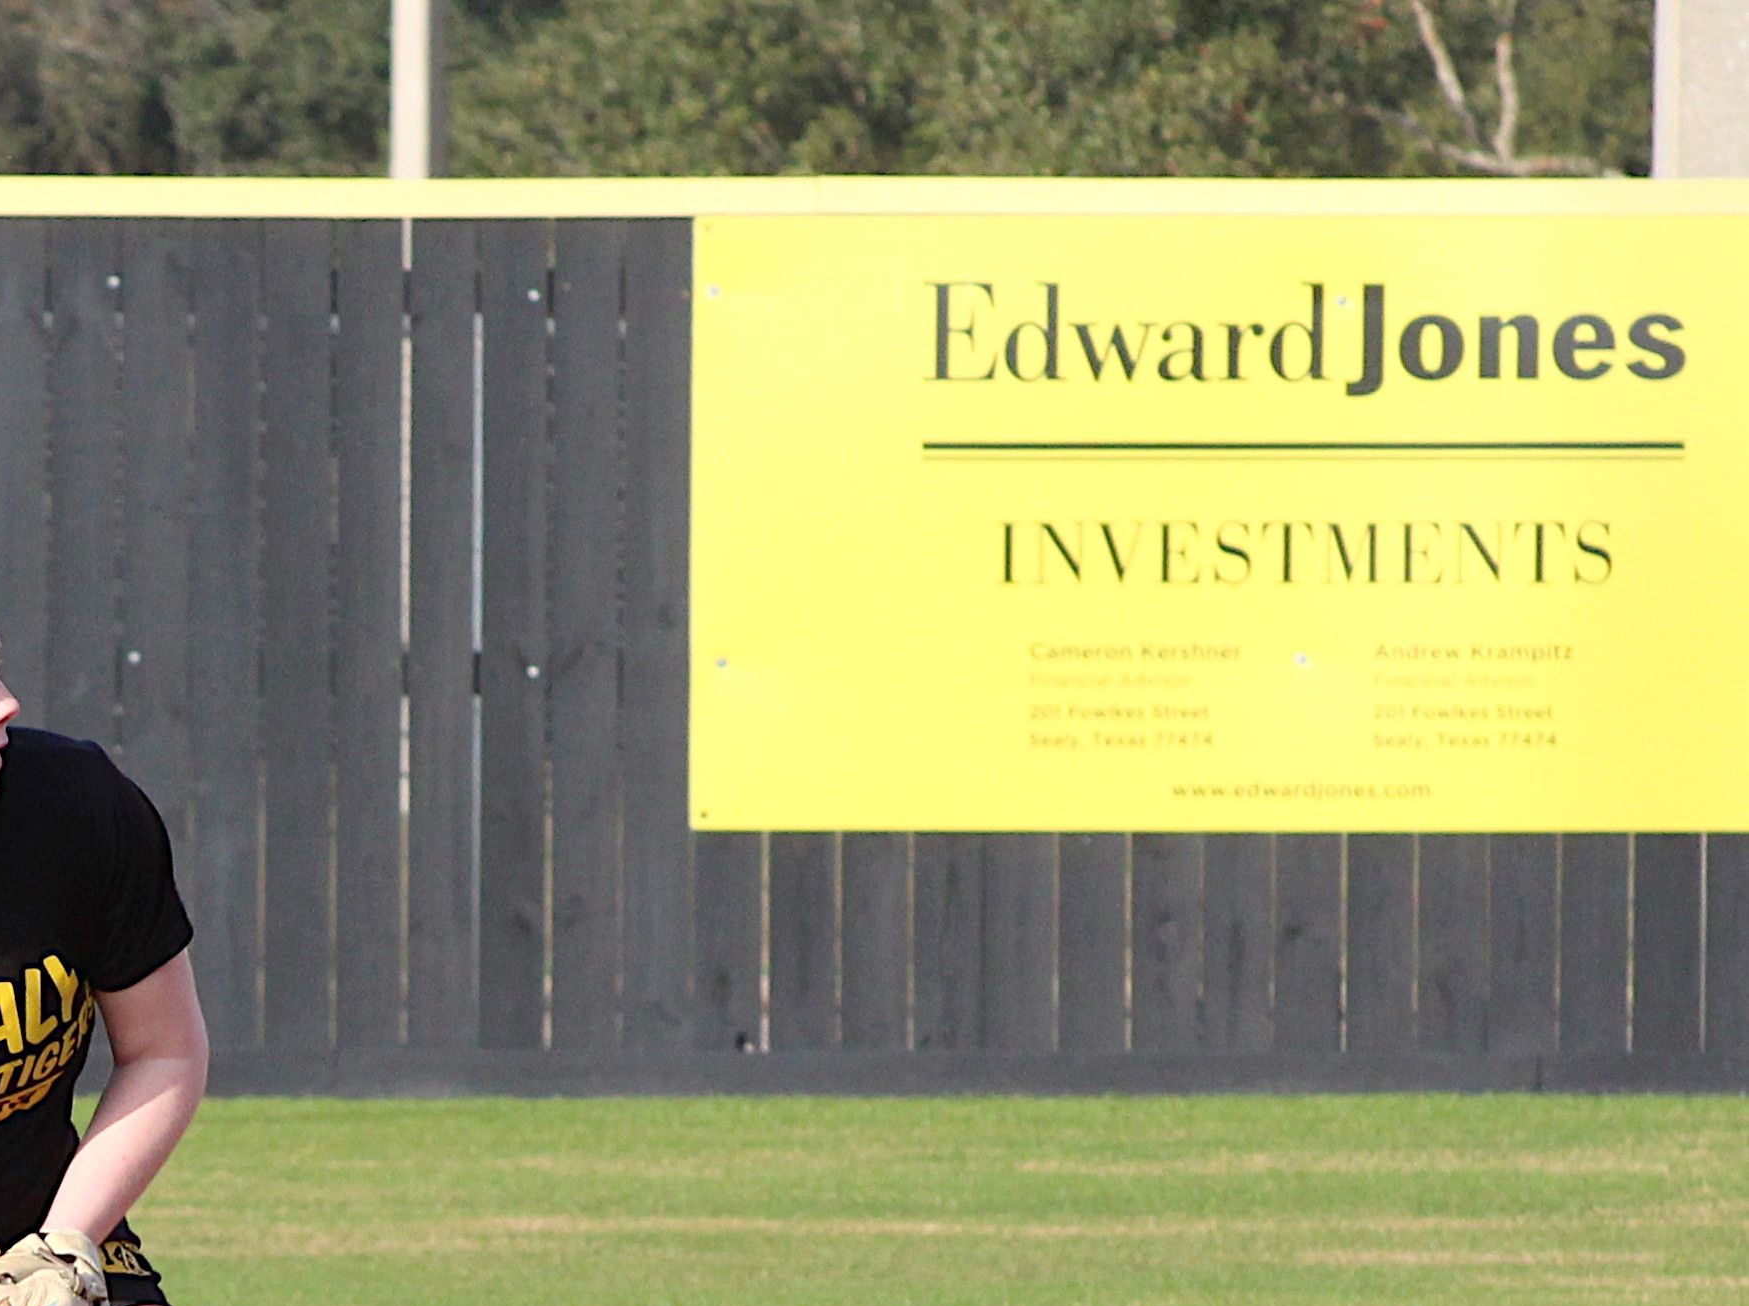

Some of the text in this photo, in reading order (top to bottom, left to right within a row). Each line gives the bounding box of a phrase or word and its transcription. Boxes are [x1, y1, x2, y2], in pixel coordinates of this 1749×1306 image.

[1000, 521, 1613, 584] INVESTMENTS
[1028, 641, 1242, 662] Cameron Kershner
[1374, 642, 1575, 664] Andrew Krampitz
[1028, 703, 1062, 722] 201
[1151, 704, 1210, 721] Street
[1372, 703, 1406, 722] 201
[1496, 704, 1554, 721] Street
[1092, 730, 1147, 748] Texas
[1155, 730, 1214, 748] 77474
[1436, 730, 1491, 748] Texas
[1500, 730, 1559, 748] 77474
[1171, 779, 1433, 803] www.edwardjones.com
